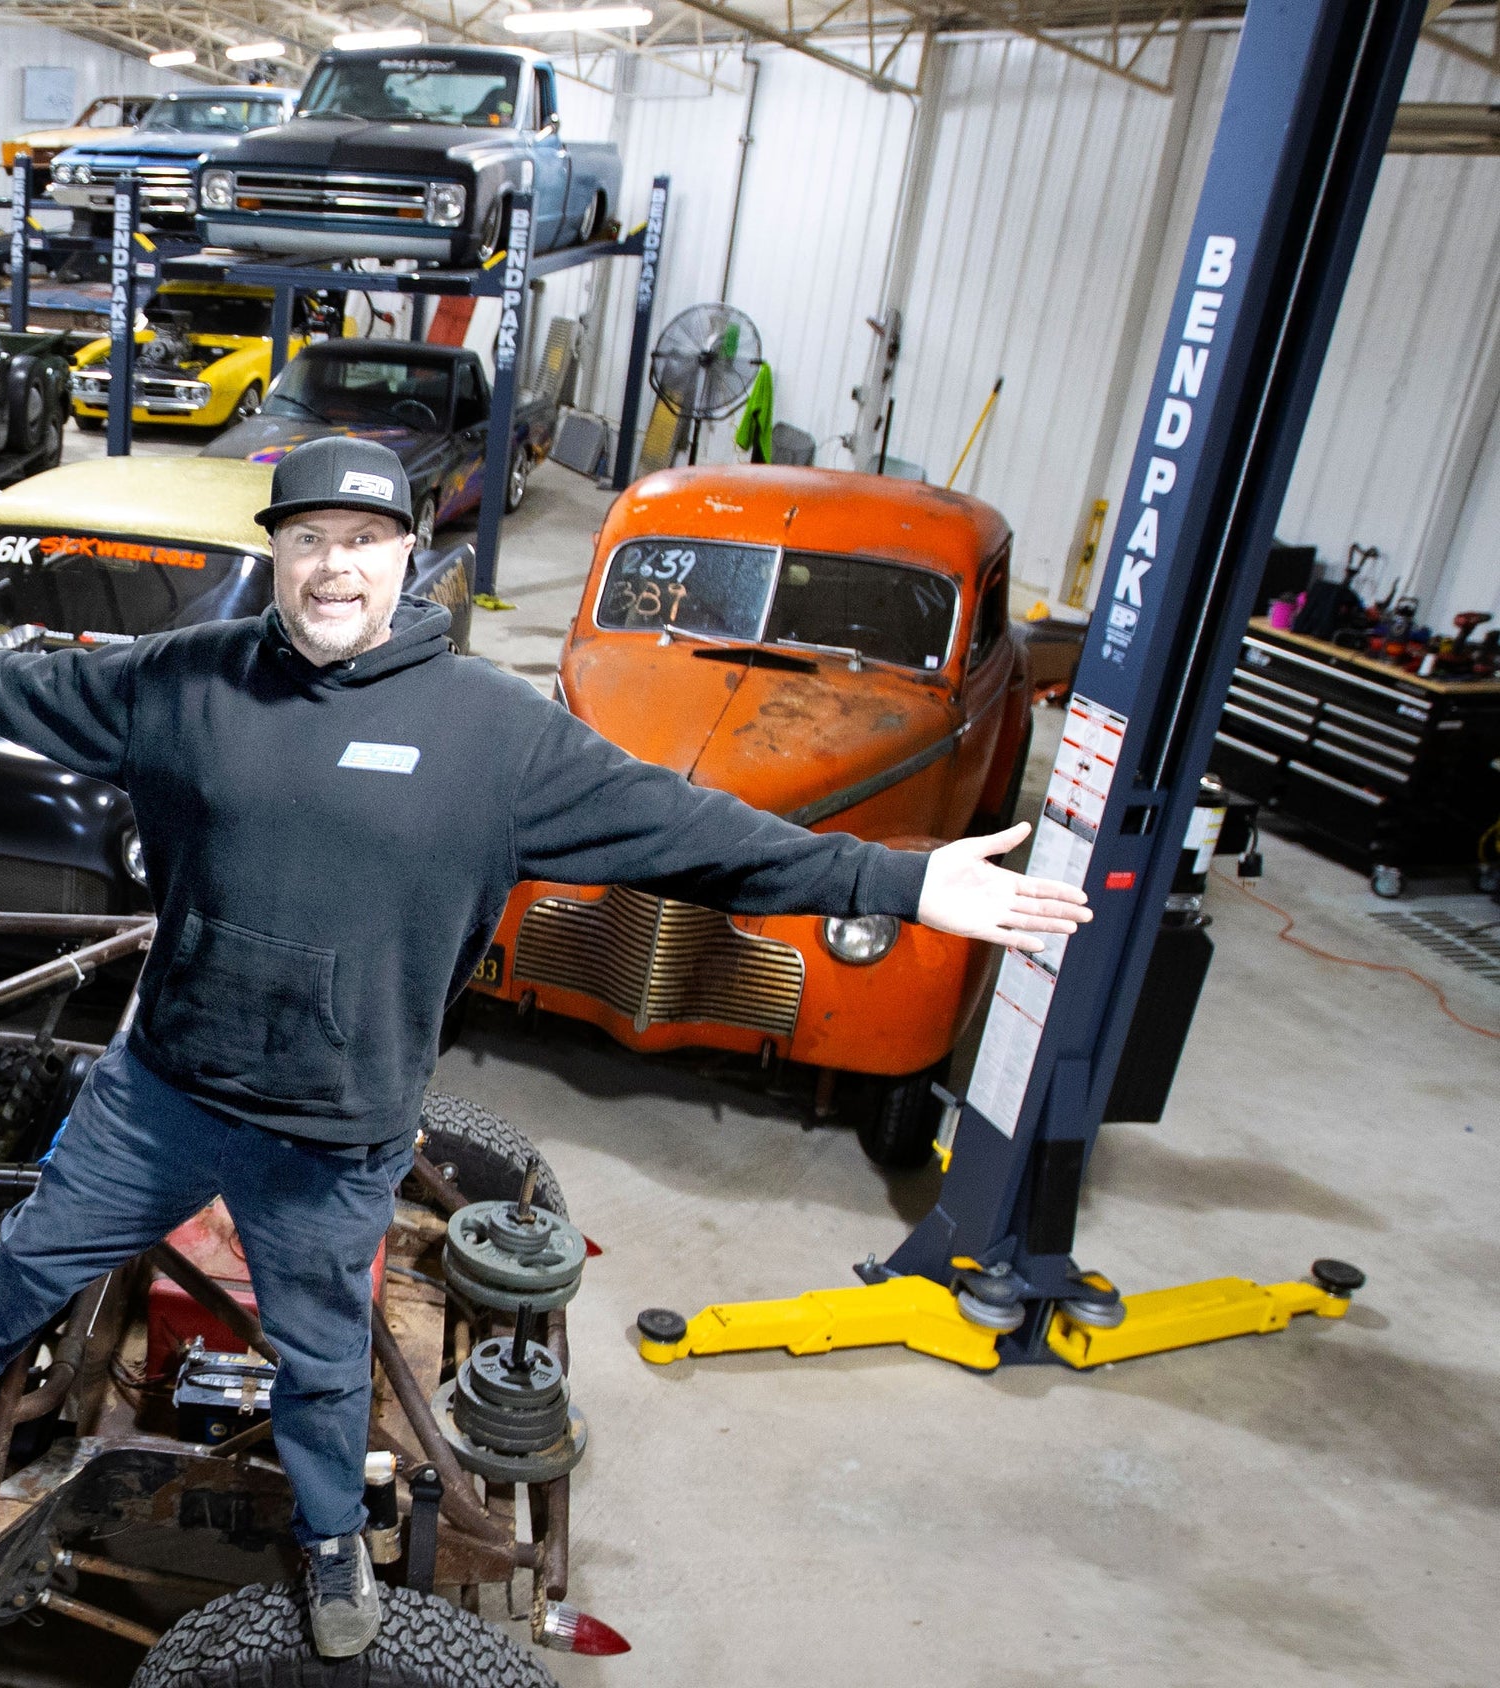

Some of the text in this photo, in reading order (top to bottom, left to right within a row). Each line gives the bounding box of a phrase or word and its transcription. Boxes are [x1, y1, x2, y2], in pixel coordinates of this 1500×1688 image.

[111, 194, 130, 320] BENDPAK
[498, 208, 530, 349] BENDPAK
[1113, 235, 1236, 607] BENDPAK
[99, 540, 152, 562] WEEK
[152, 547, 208, 570] 2025
